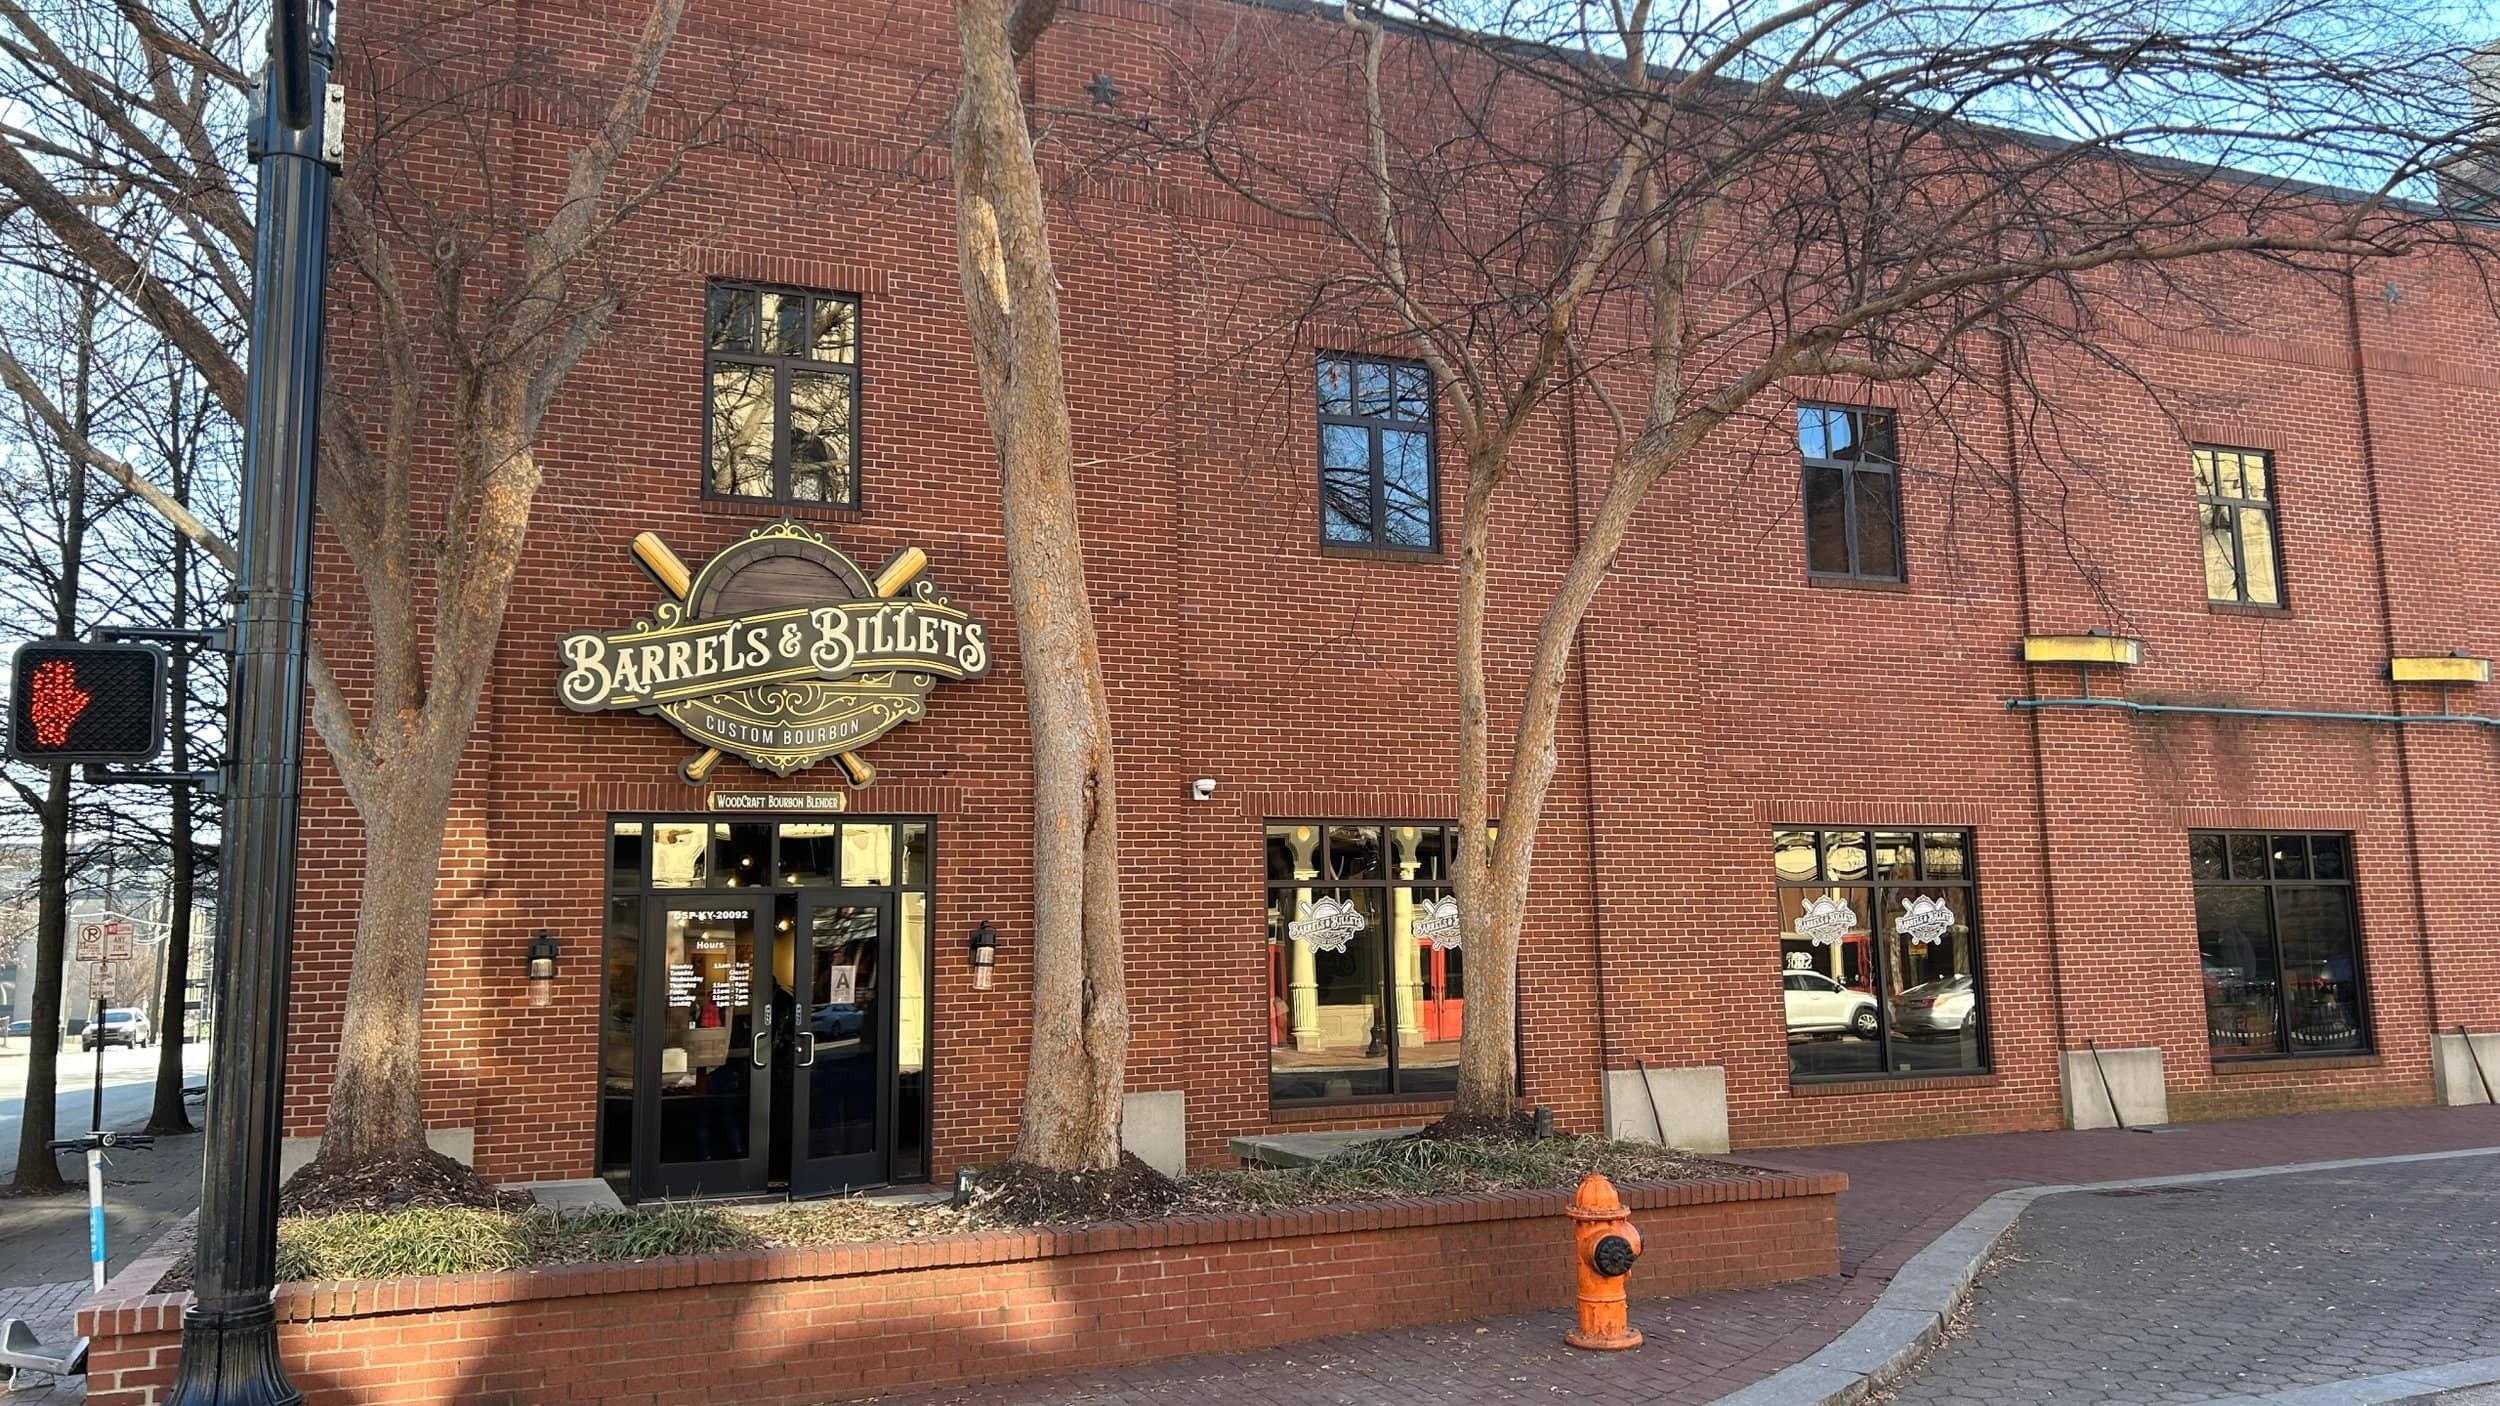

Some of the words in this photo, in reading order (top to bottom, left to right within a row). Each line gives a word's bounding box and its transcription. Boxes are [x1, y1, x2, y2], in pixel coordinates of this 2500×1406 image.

[563, 622, 770, 705] BARRELS
[778, 623, 802, 658] &
[809, 604, 986, 673] BILLETS
[706, 715, 773, 744] CUSTOM
[783, 719, 859, 745] BOURBON
[674, 911, 748, 919] DSP-KY-20092
[696, 941, 725, 949] Hours
[836, 973, 849, 988] A
